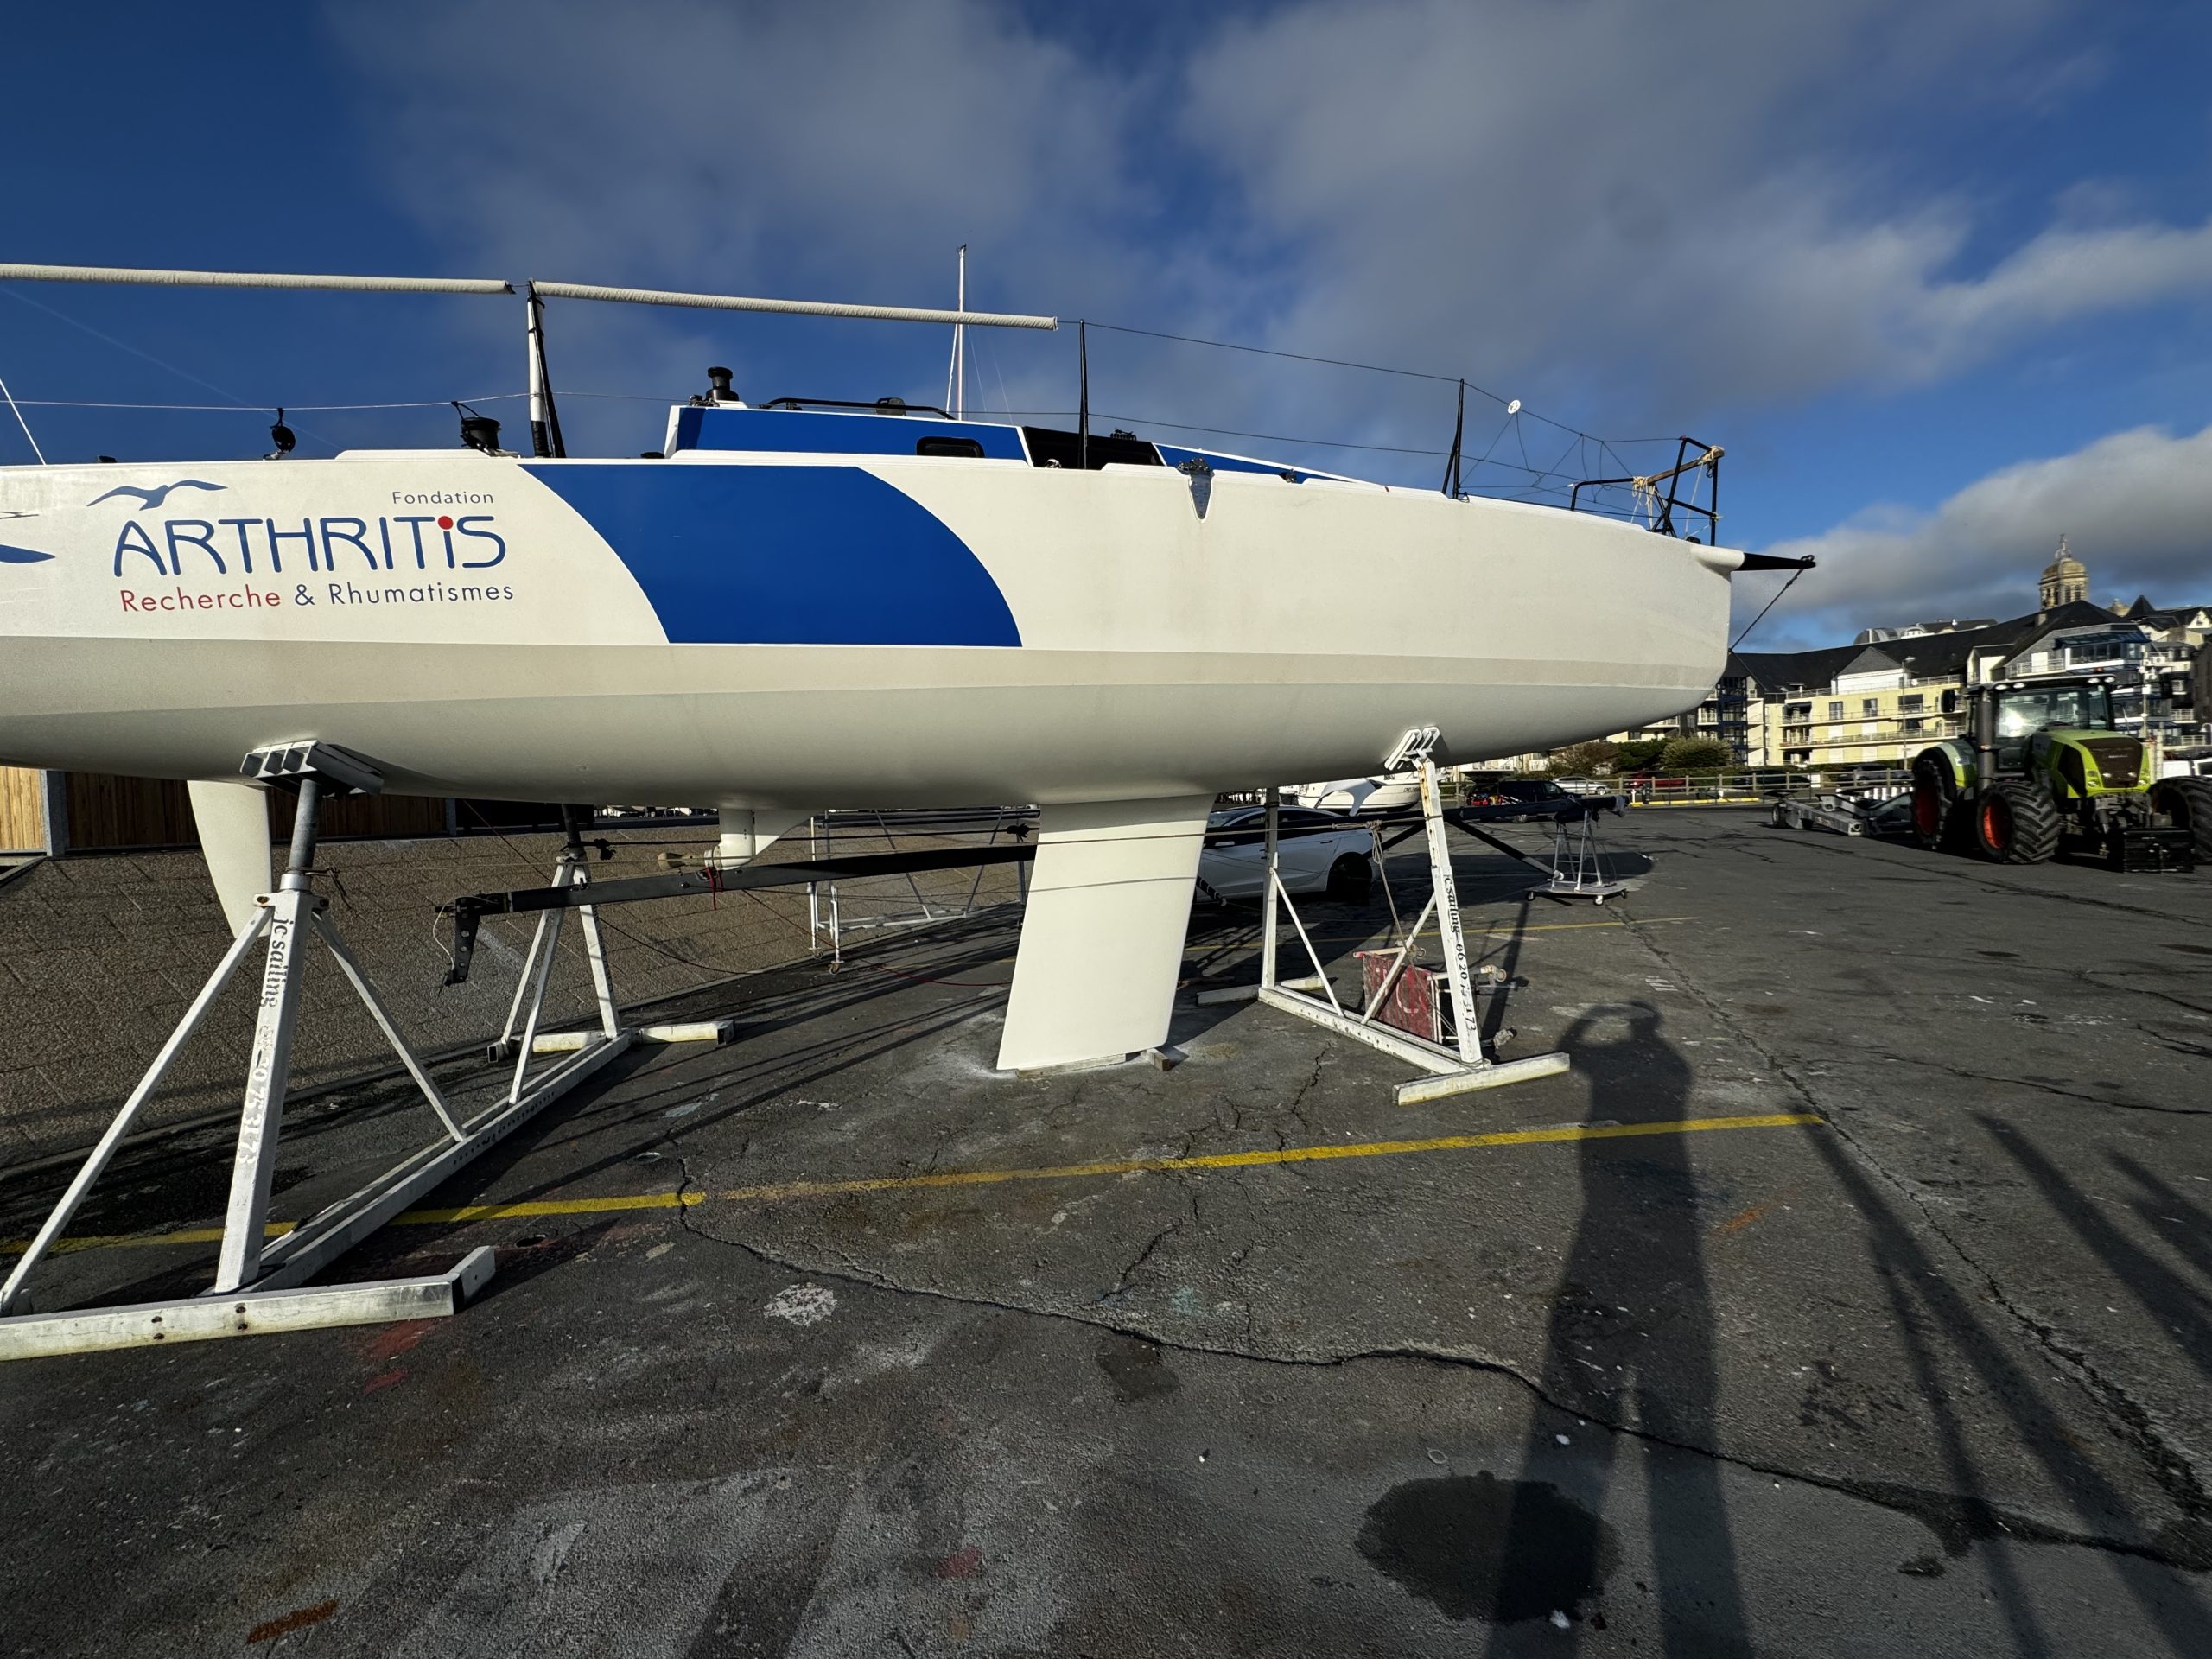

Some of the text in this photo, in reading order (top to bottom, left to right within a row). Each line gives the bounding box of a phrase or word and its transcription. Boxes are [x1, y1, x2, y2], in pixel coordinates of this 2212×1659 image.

[392, 491, 493, 505] Fondation
[120, 582, 514, 612] Recherche & Rhumatismes
[1459, 963, 1468, 980] 20
